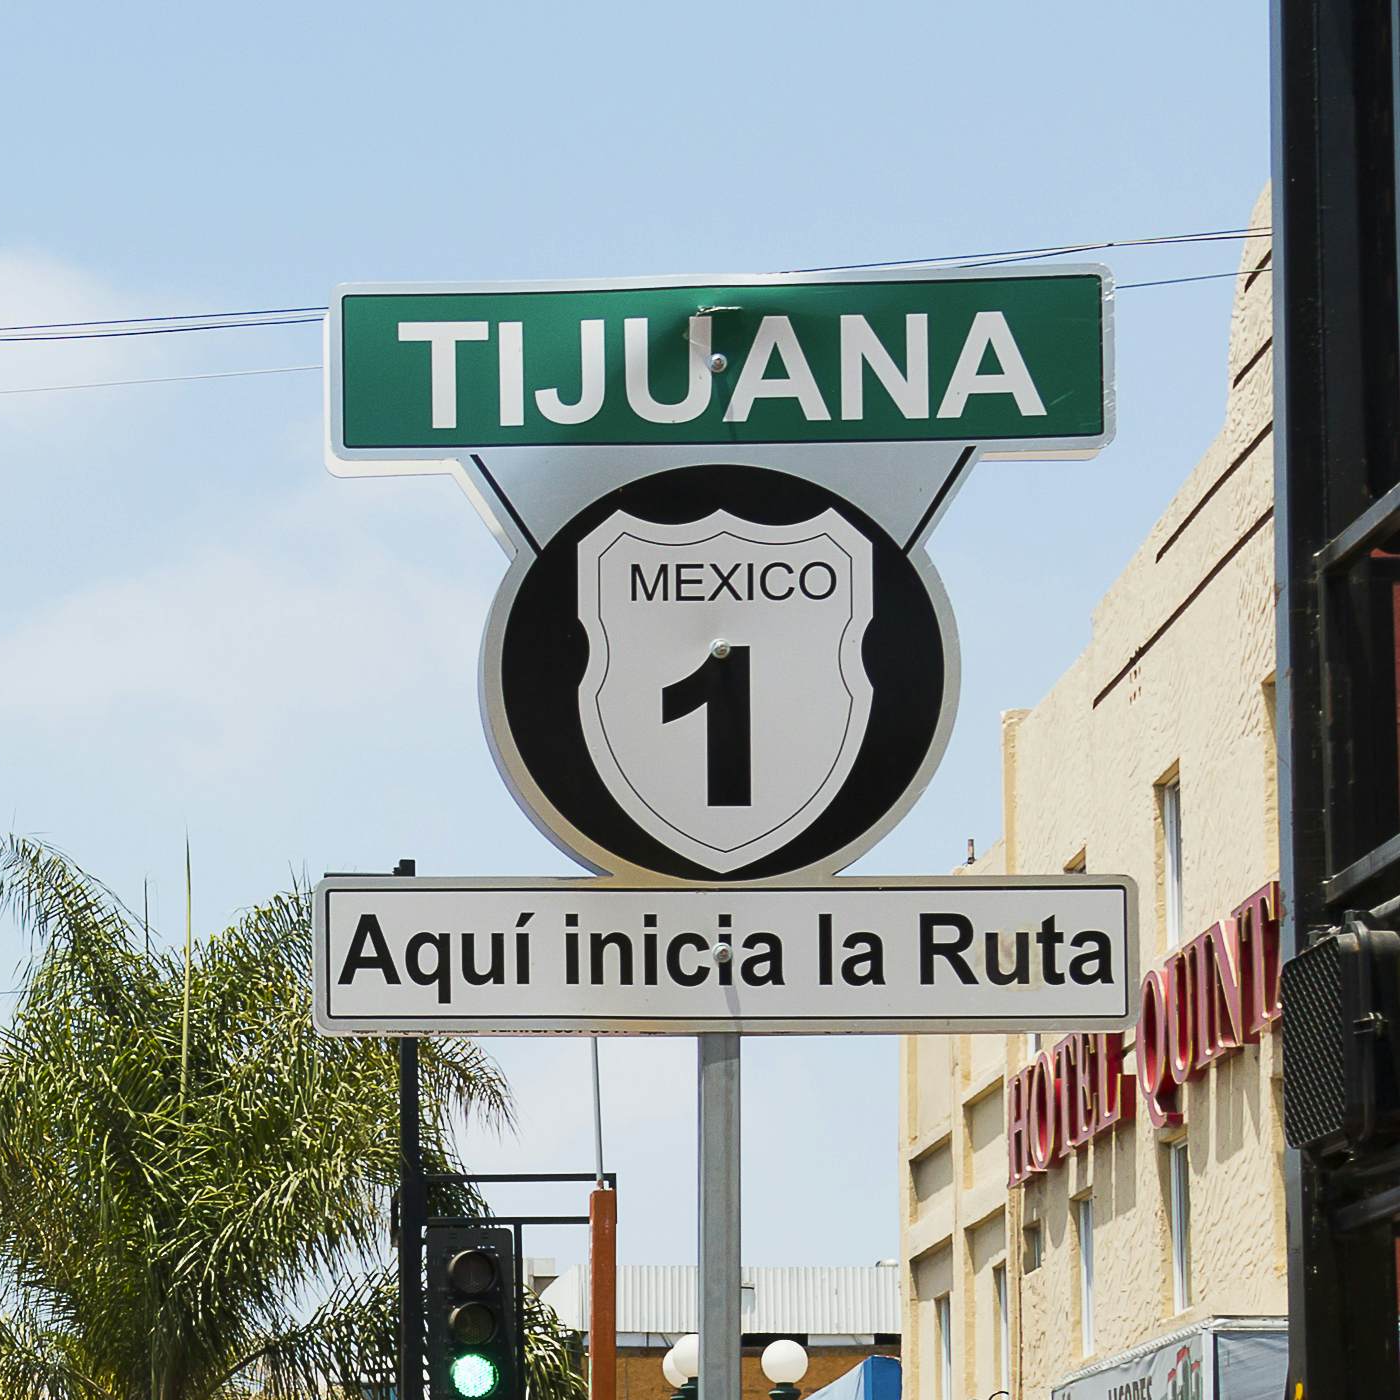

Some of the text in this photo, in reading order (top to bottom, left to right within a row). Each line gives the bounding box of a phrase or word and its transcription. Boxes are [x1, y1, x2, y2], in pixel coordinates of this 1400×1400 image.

[398, 311, 1048, 429] TIJUANA
[630, 561, 838, 602] MEXICO
[661, 645, 753, 807] 1
[337, 911, 1115, 1002] Aquí inicia la Ruta
[1007, 880, 1282, 1190] HOTEL QUINT
